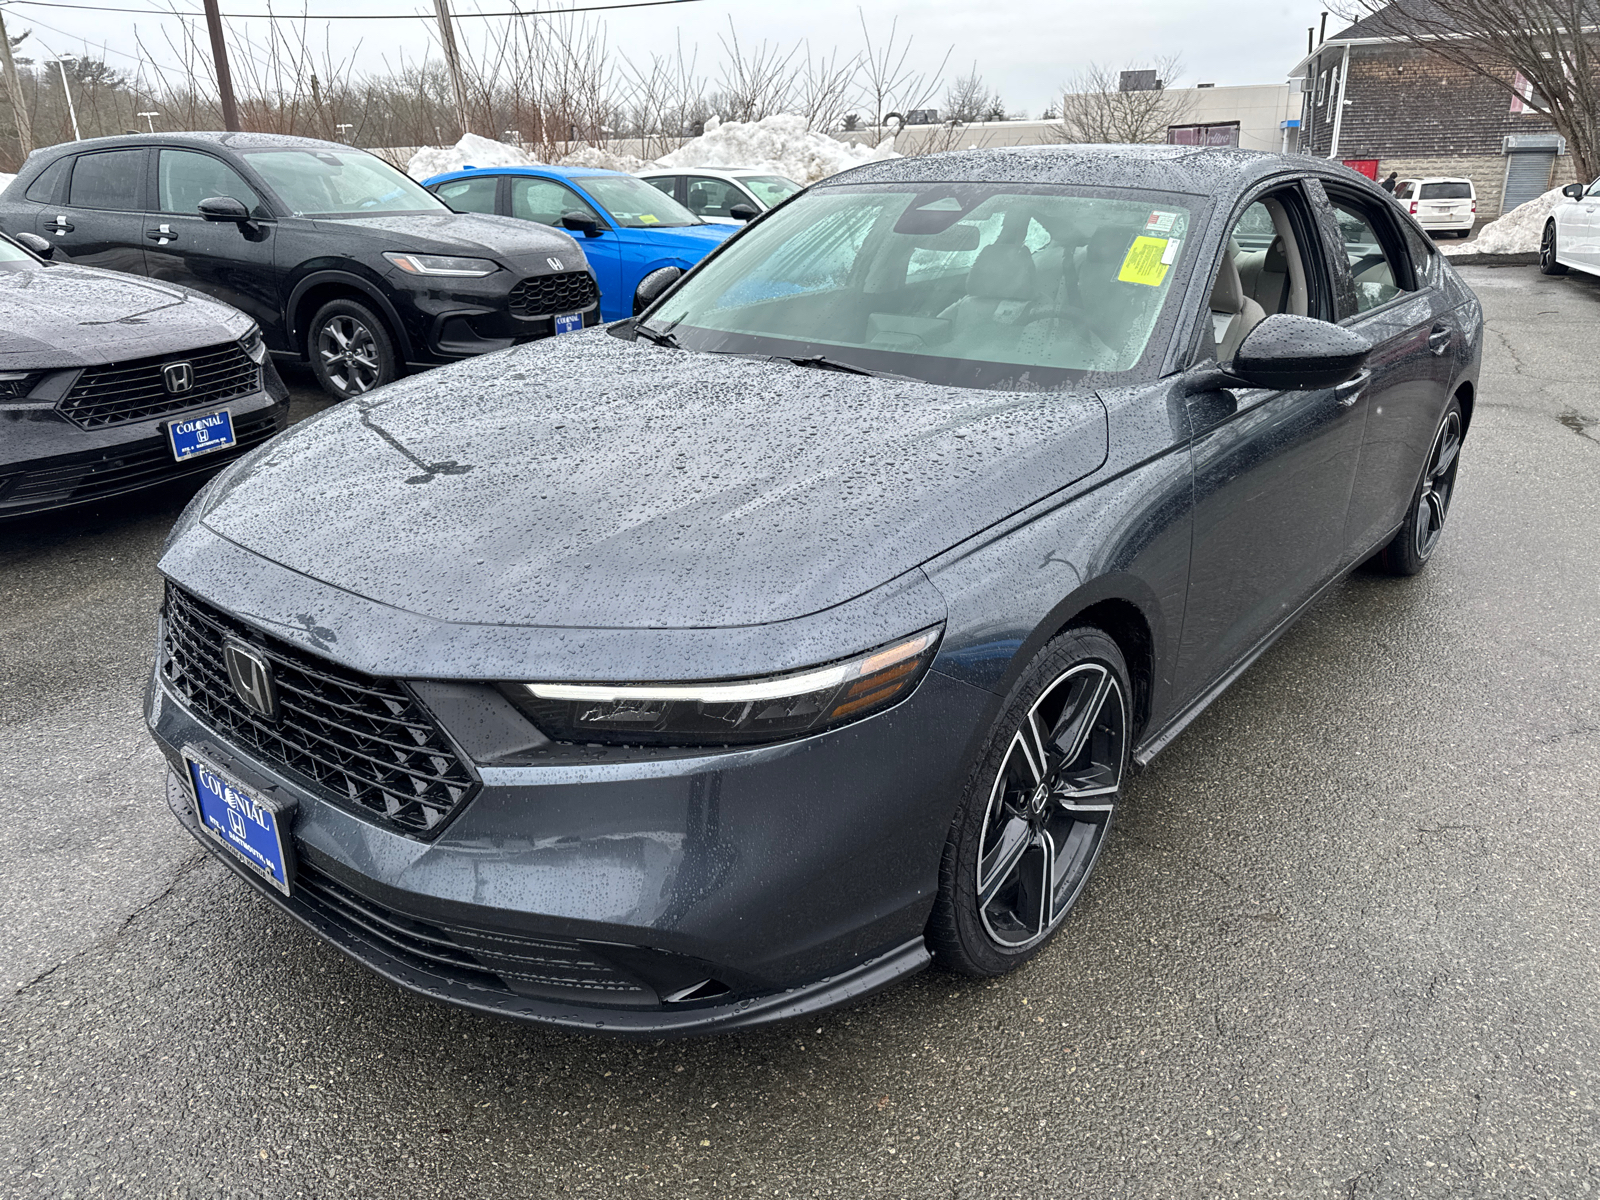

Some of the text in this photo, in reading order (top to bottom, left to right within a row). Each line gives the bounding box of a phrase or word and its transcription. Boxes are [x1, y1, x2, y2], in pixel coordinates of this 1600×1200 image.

[176, 416, 223, 434] COLONIAL
[200, 769, 270, 831] COLONIAL
[228, 831, 276, 871] DARTMOUTH, MA
